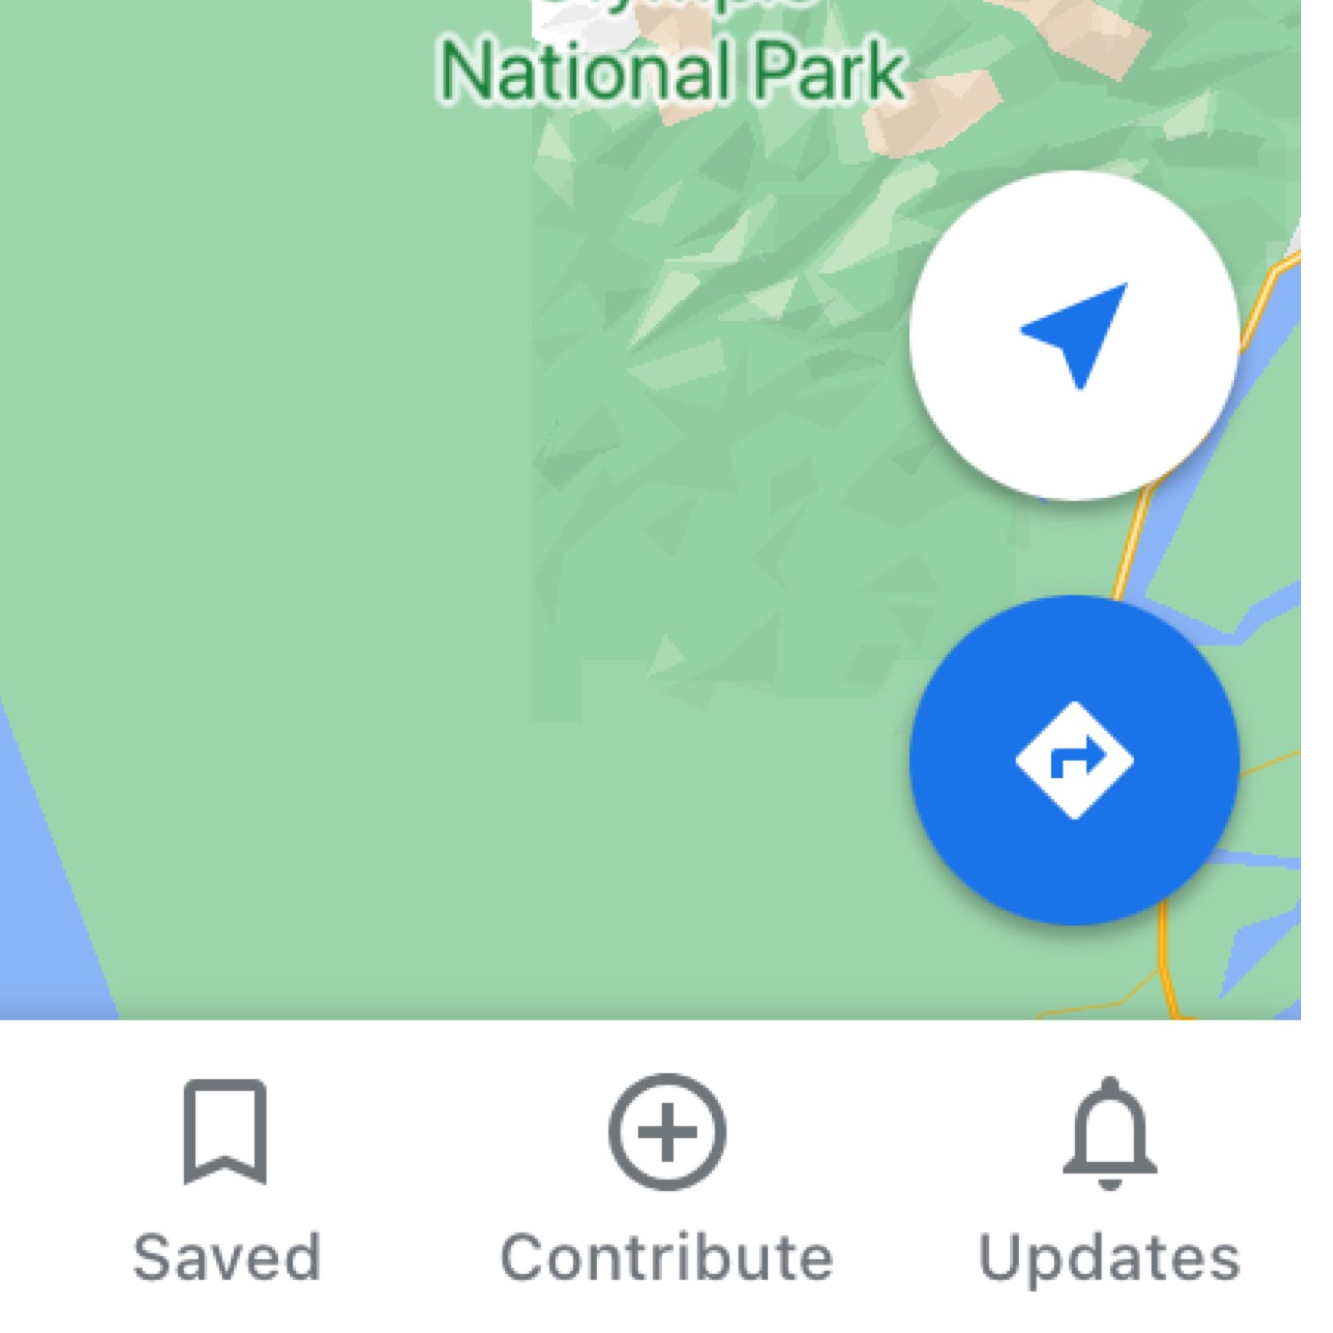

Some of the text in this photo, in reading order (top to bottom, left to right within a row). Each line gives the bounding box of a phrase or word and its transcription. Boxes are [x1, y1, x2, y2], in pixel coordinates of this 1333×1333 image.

[444, 40, 904, 99] National Park
[133, 1231, 319, 1281] Saved
[501, 1230, 833, 1281] Contribute
[980, 1231, 1241, 1292] Updates
